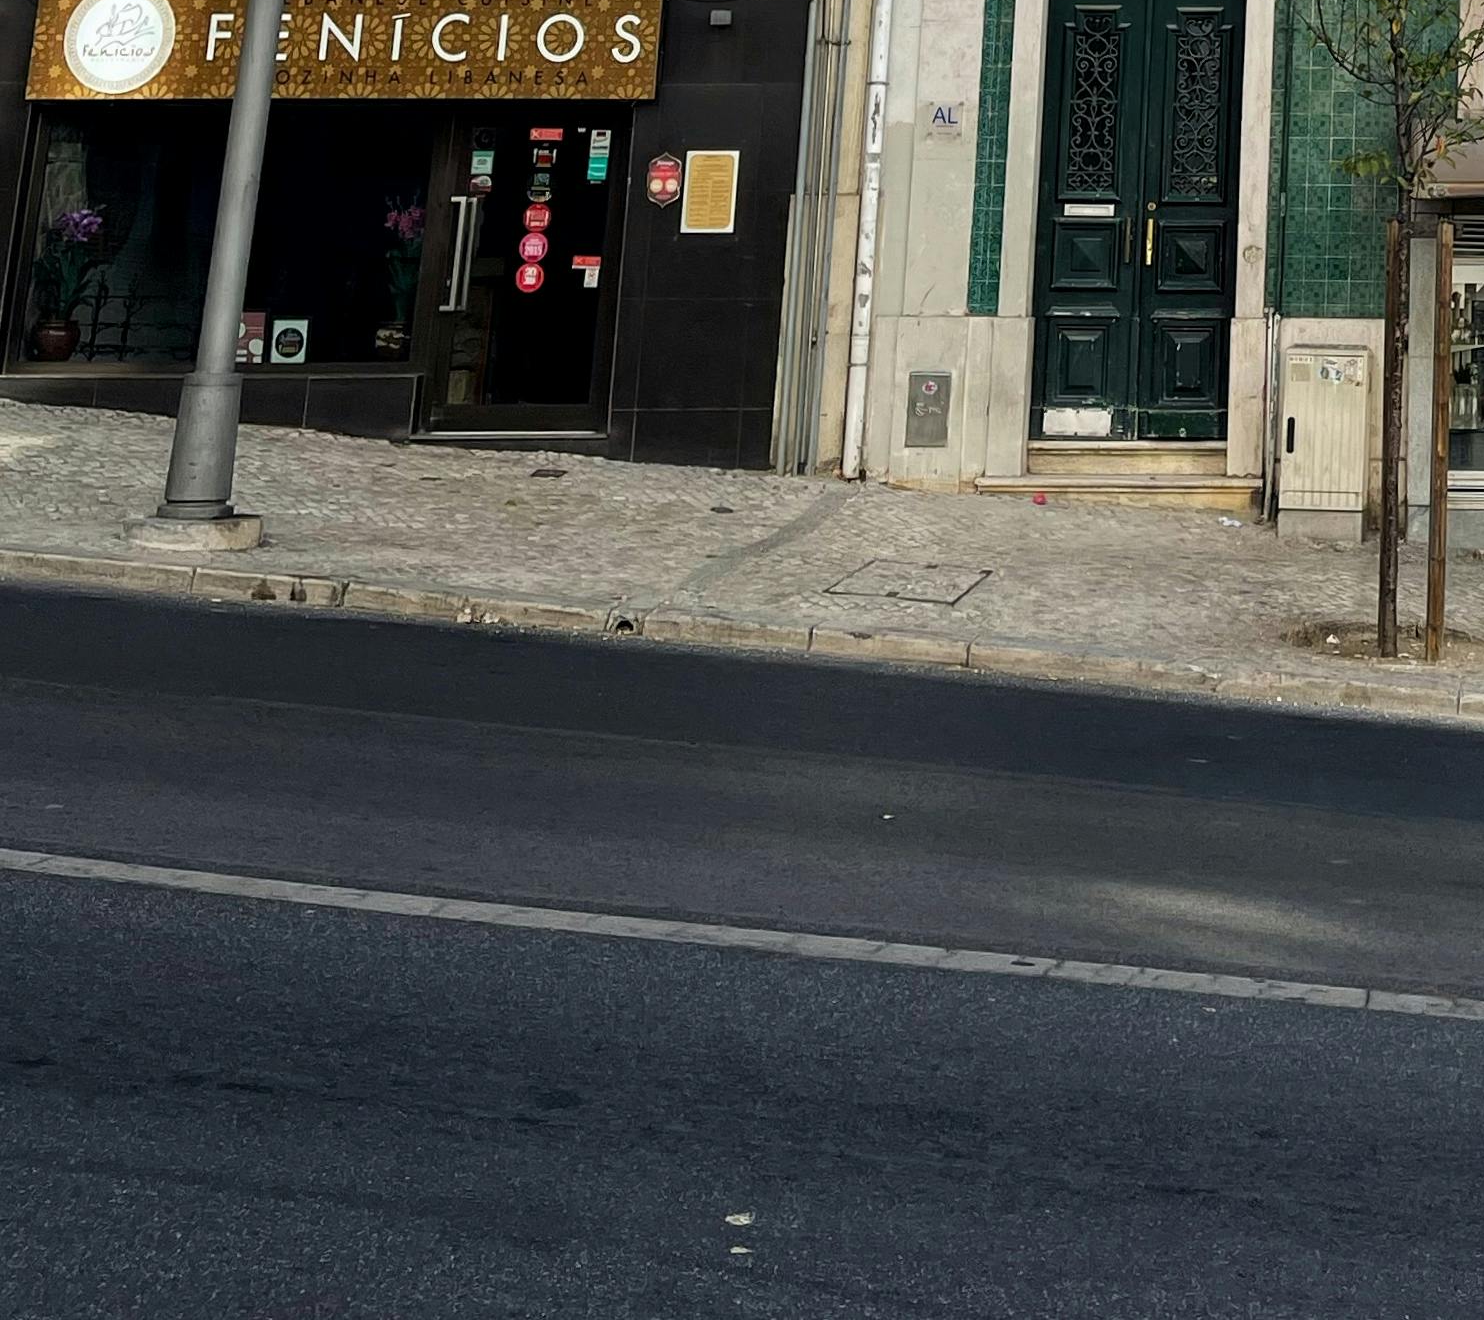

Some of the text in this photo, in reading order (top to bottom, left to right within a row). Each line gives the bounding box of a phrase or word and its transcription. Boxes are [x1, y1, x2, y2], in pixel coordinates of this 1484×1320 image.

[274, 69, 589, 86] OZINHA LIBANESA
[931, 106, 958, 124] AL
